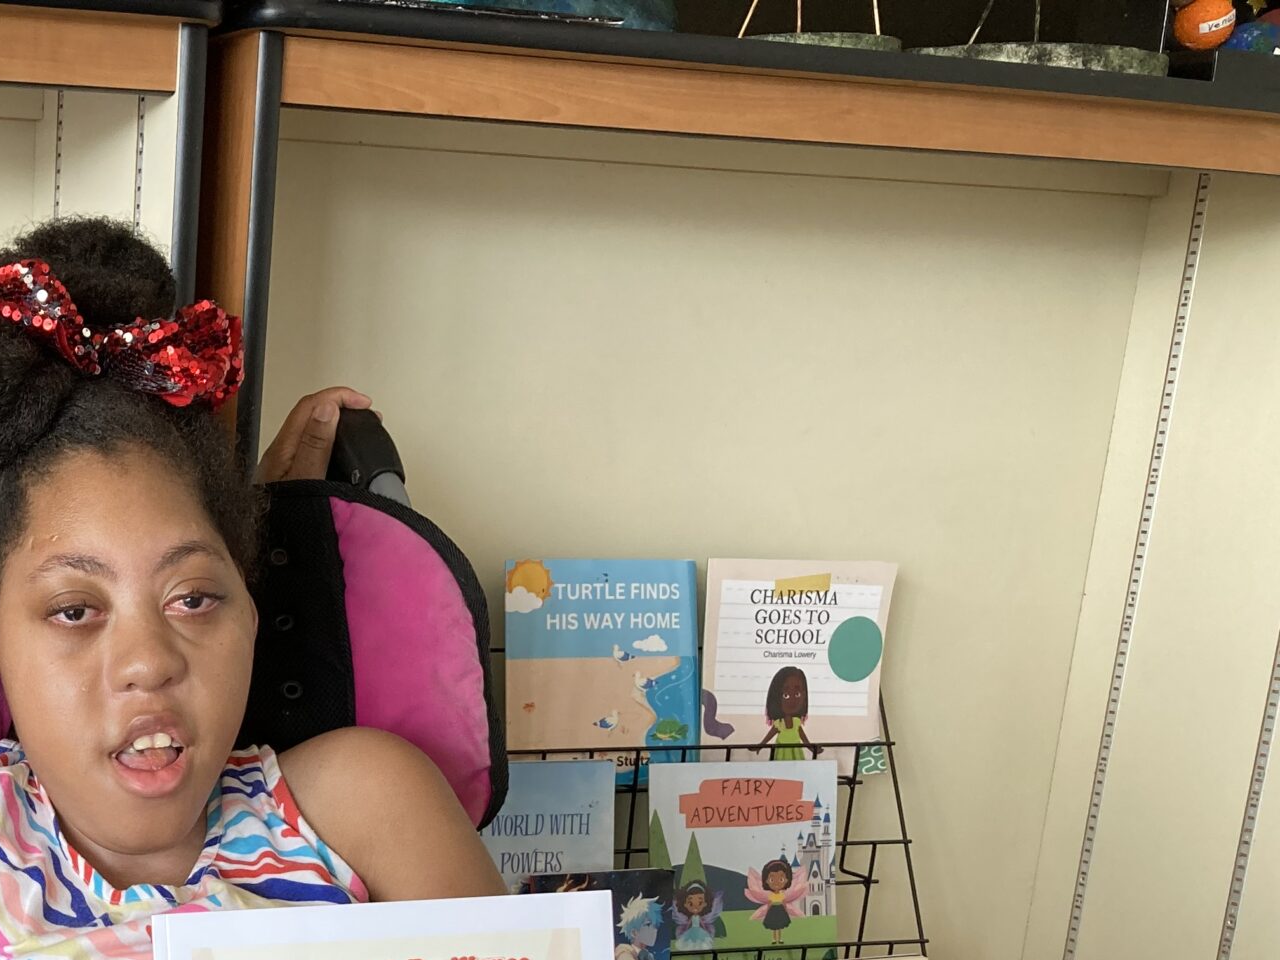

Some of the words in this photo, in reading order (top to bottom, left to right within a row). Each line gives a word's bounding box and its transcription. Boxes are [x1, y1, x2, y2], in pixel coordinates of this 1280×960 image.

[554, 582, 626, 600] TURTLE
[630, 582, 680, 600] FINDS
[750, 588, 838, 606] CHARISMA
[546, 613, 578, 630] HIS
[583, 612, 625, 629] WAY
[629, 612, 680, 629] HOME
[754, 608, 802, 625] GOES
[805, 609, 830, 625] TO
[754, 628, 826, 645] SCHOOL
[616, 755, 651, 767] Stutz
[721, 779, 776, 797] FAIRY
[690, 804, 806, 825] ADVENTURES
[490, 813, 545, 837] WORLD
[549, 812, 591, 837] WITH
[500, 848, 564, 874] POWERS
